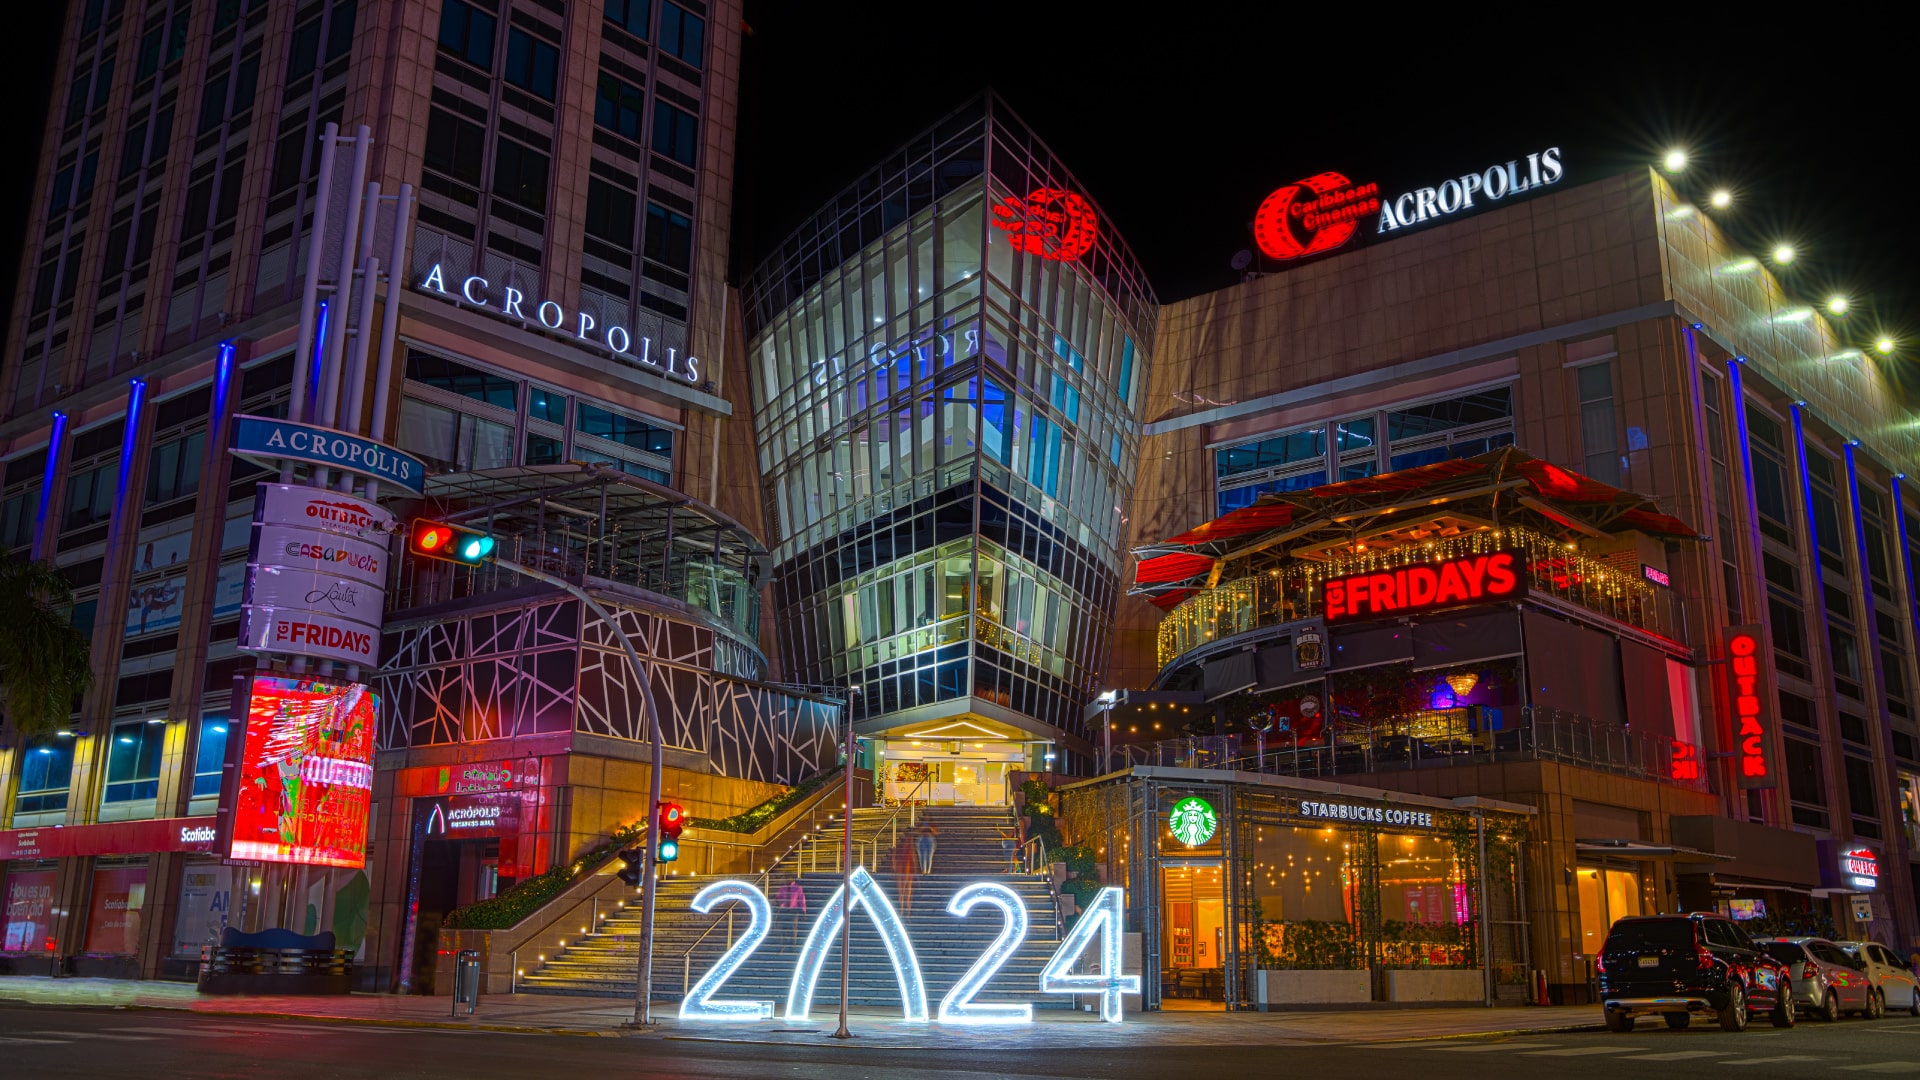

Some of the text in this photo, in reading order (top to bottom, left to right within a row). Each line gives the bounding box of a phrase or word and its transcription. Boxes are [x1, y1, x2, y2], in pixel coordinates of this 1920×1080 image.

[1290, 182, 1378, 217] Caribbean
[1377, 147, 1563, 233] ACROPOLIS
[1303, 197, 1380, 231] Cinemas
[421, 263, 699, 382] ACROPOLIS
[266, 427, 410, 480] ACROPOLIS
[305, 505, 373, 528] OUTBACK
[1325, 554, 1516, 619] TGI FRIDAYS
[276, 621, 371, 655] TGI FRIDAYS
[1296, 634, 1320, 645] BEER
[1731, 635, 1767, 777] OUTBACK
[1301, 801, 1432, 827] STARBUCKS COFFEE
[28, 886, 39, 898] es
[40, 884, 51, 898] un
[6, 901, 29, 916] buen
